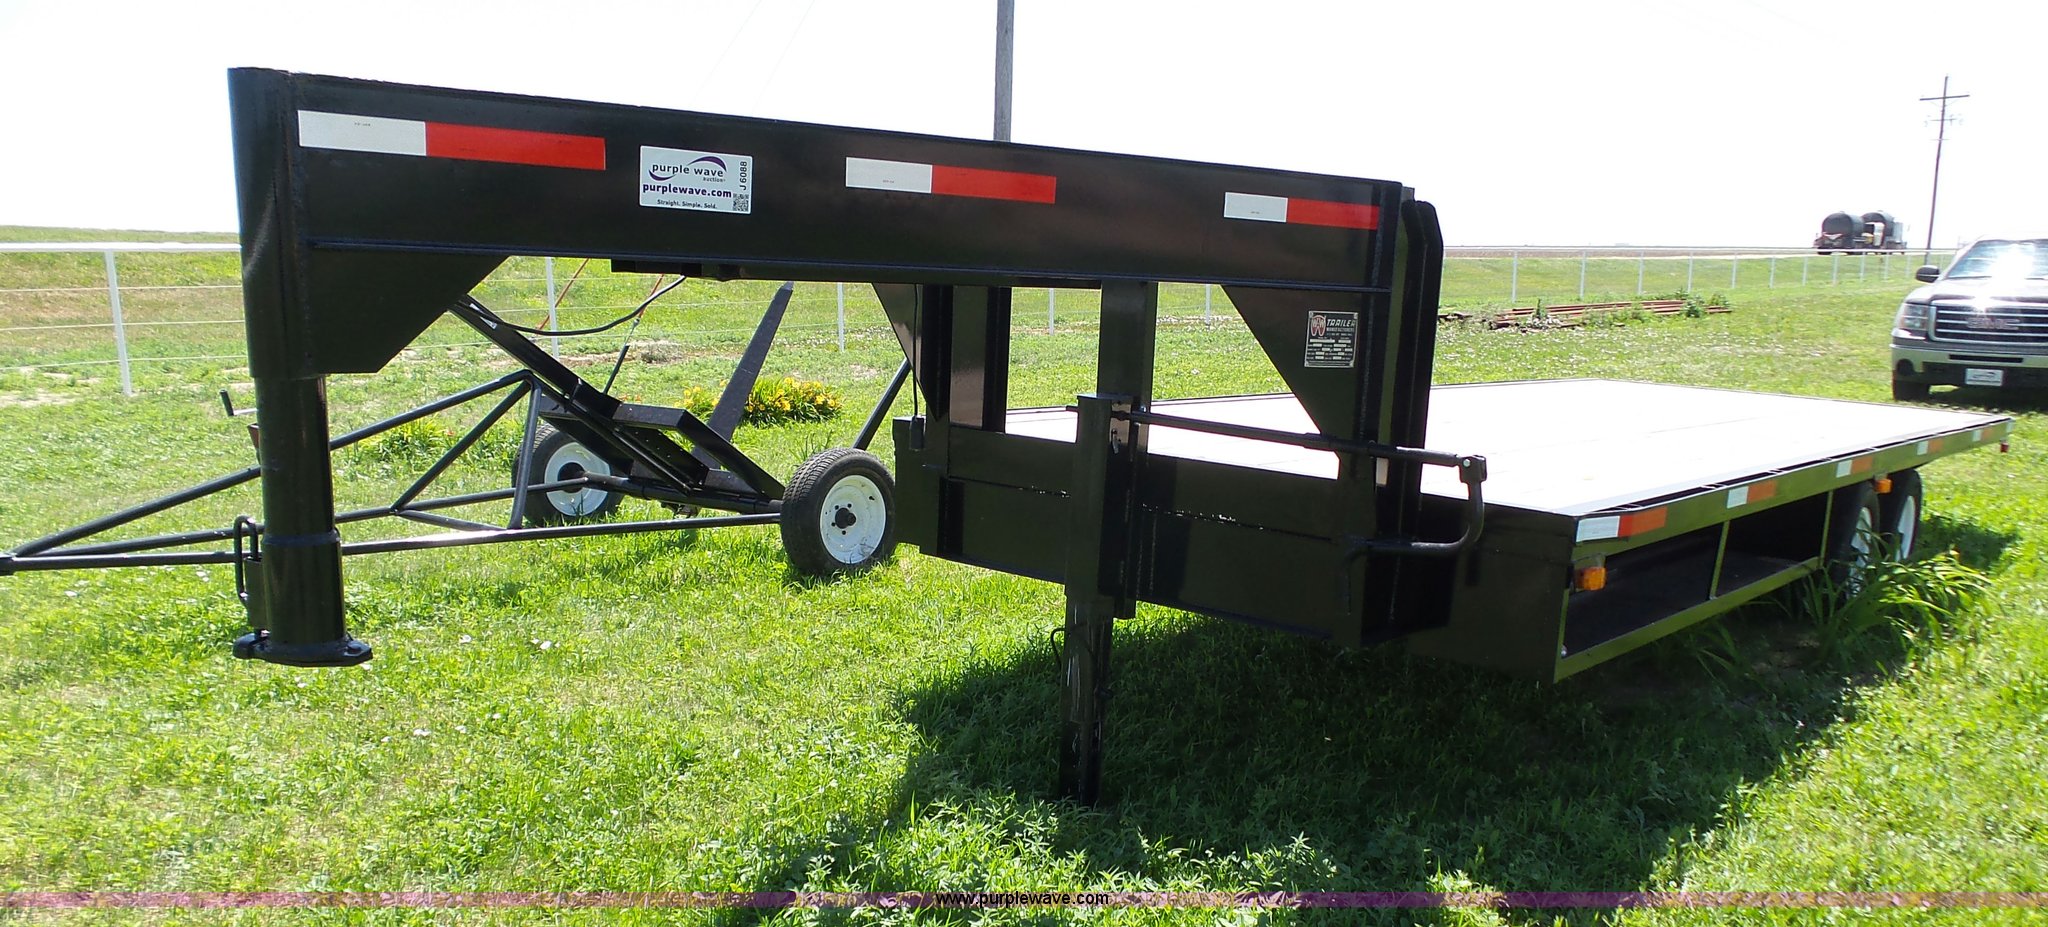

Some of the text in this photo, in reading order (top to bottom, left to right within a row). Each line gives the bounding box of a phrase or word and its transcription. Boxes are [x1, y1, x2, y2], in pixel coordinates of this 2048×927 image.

[652, 164, 724, 177] purple wave
[740, 161, 748, 183] 6088
[643, 184, 732, 198] purplewave.com
[657, 199, 681, 207] Straight.
[1327, 319, 1356, 327] TRAILER
